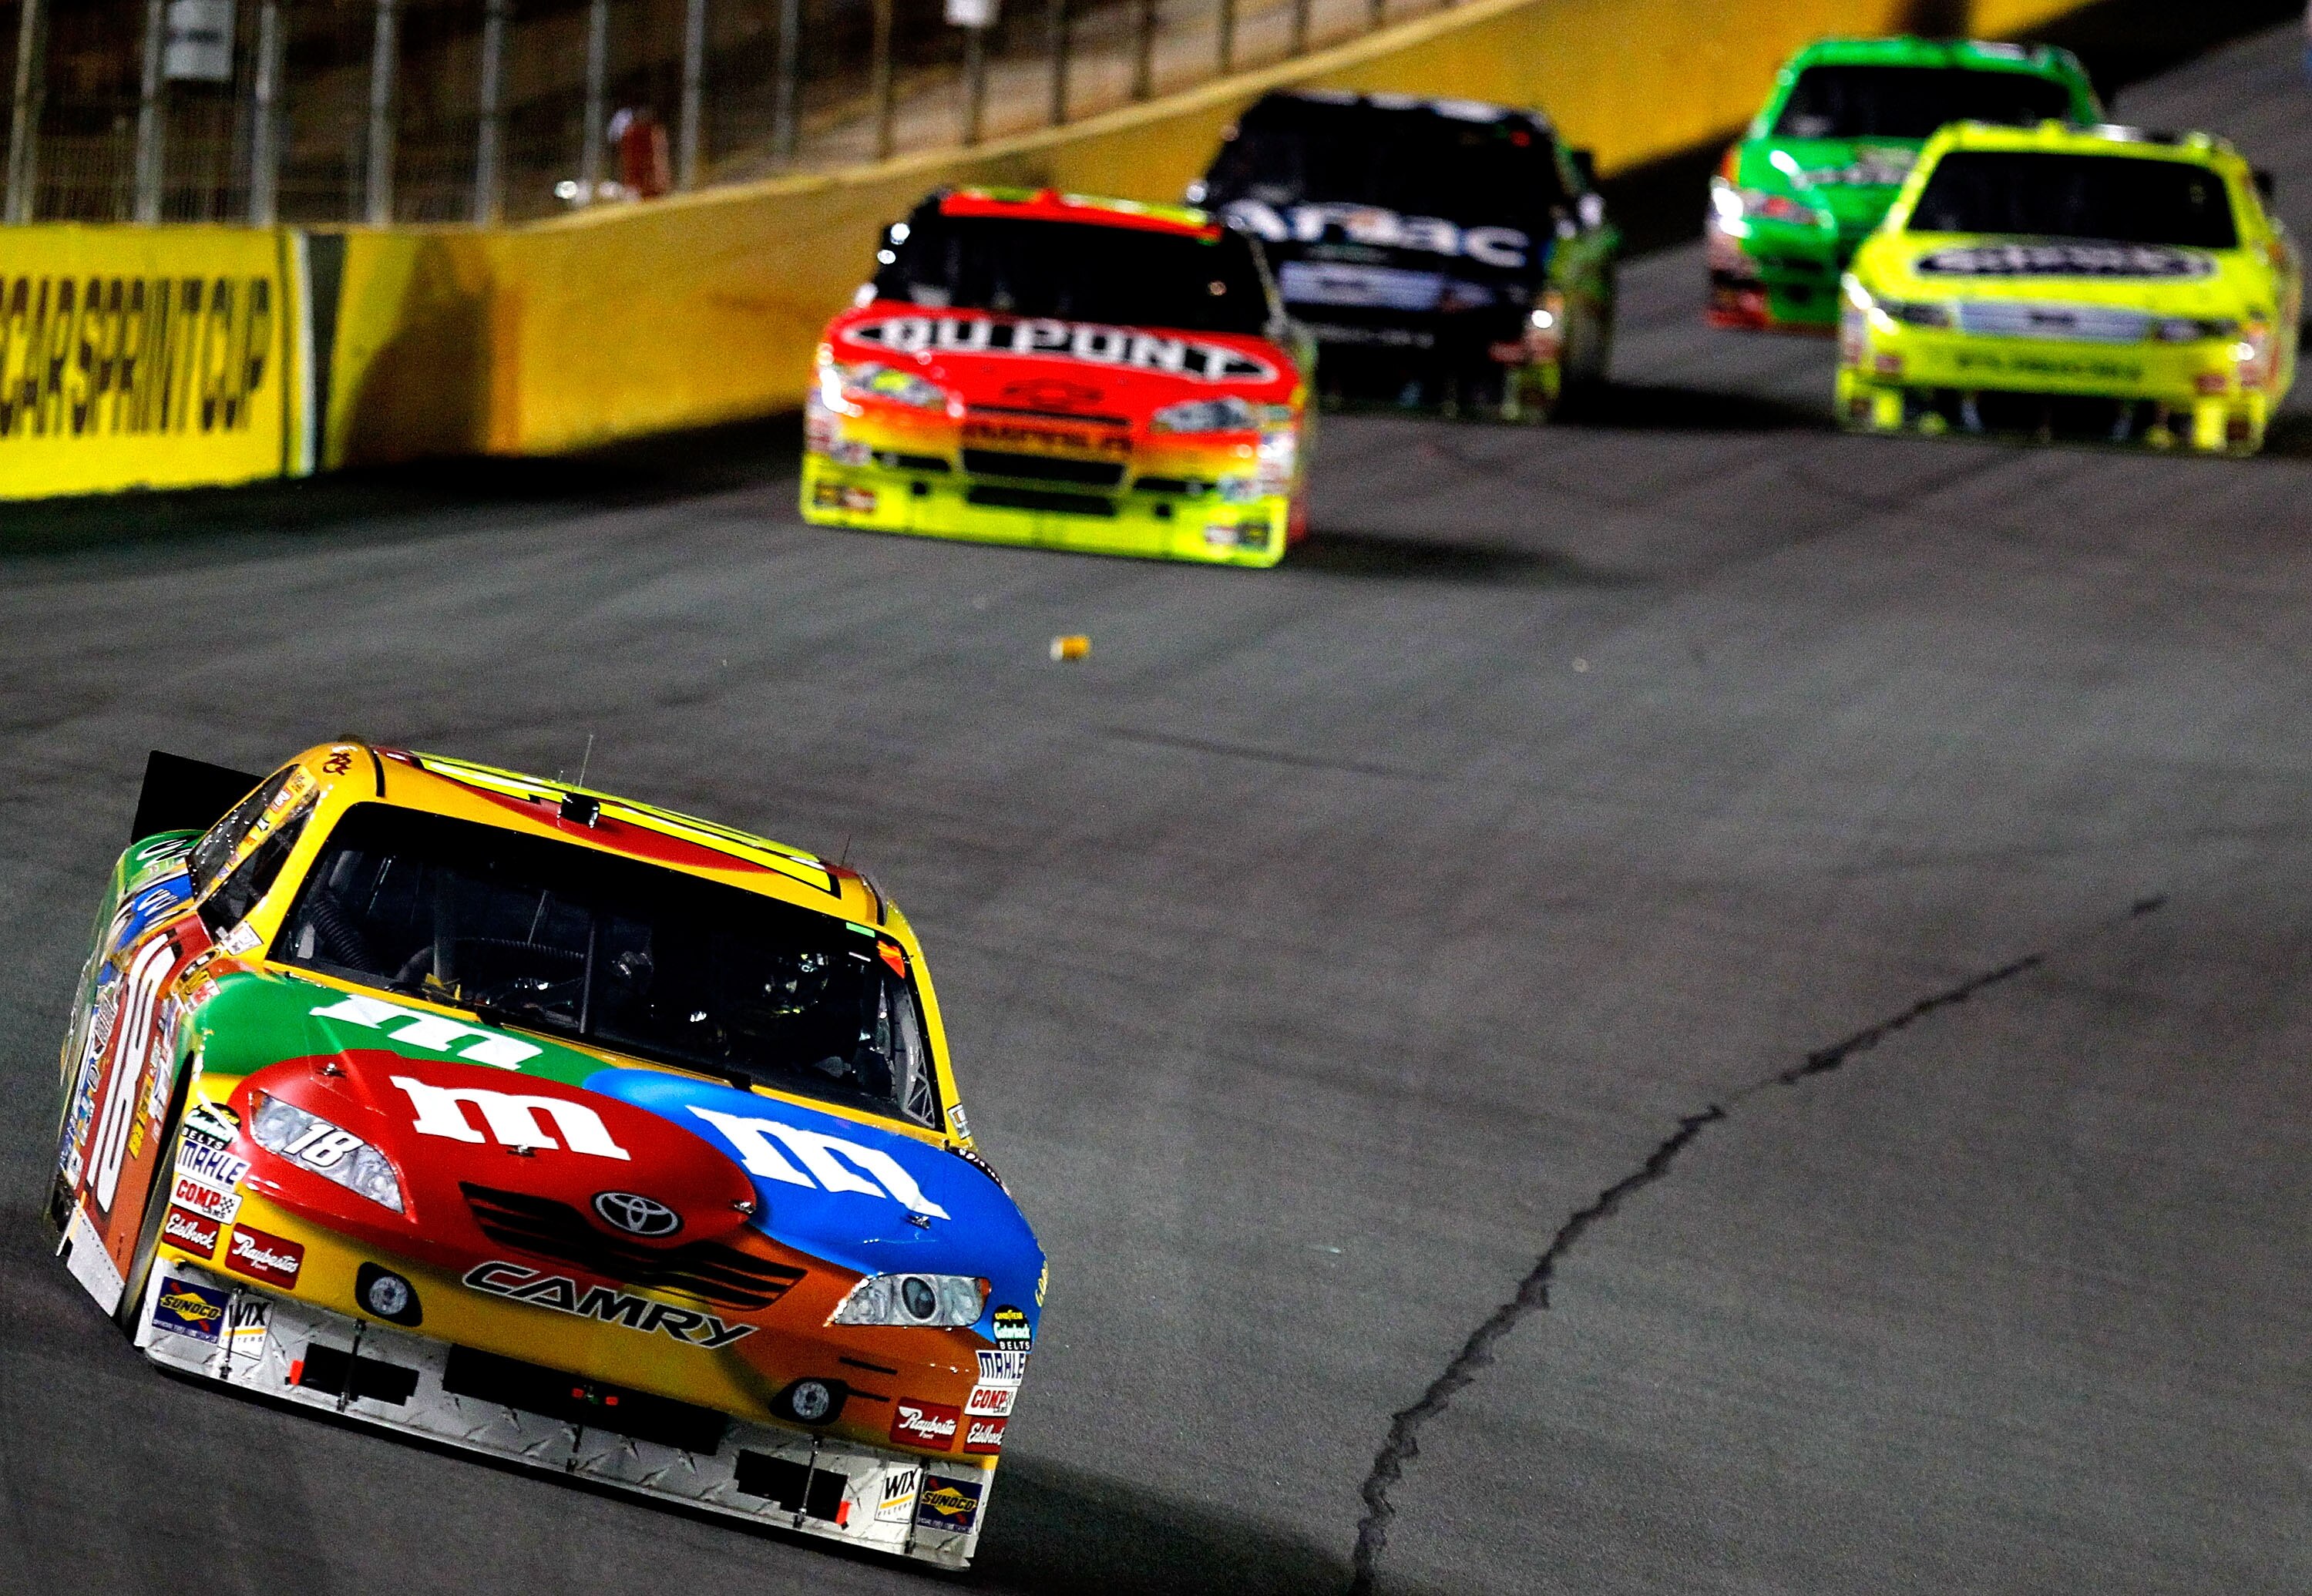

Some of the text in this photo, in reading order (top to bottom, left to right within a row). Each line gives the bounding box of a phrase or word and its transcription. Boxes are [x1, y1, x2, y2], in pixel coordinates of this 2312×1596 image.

[1011, 318, 1235, 381] PONT
[309, 993, 543, 1070] m
[389, 1075, 632, 1161] m
[182, 1127, 225, 1150] BELTS
[282, 1124, 365, 1168] 18
[177, 1140, 247, 1186] MAHLE
[685, 1104, 952, 1220] m
[176, 1179, 221, 1208] COMP
[202, 1205, 227, 1220] CAMS
[165, 1213, 217, 1250] Edelbrock
[232, 1231, 299, 1273] Raybestos
[162, 1295, 221, 1320] SUNOCO
[229, 1301, 271, 1327] WIX
[462, 1261, 760, 1349] CAMRY
[220, 1336, 264, 1345] FTERS
[999, 1341, 1030, 1350] BELTS
[977, 1352, 1025, 1379] MAHLE
[971, 1389, 1008, 1410] COMP
[885, 1467, 919, 1500] WIX
[922, 1492, 976, 1511] SUNOCO
